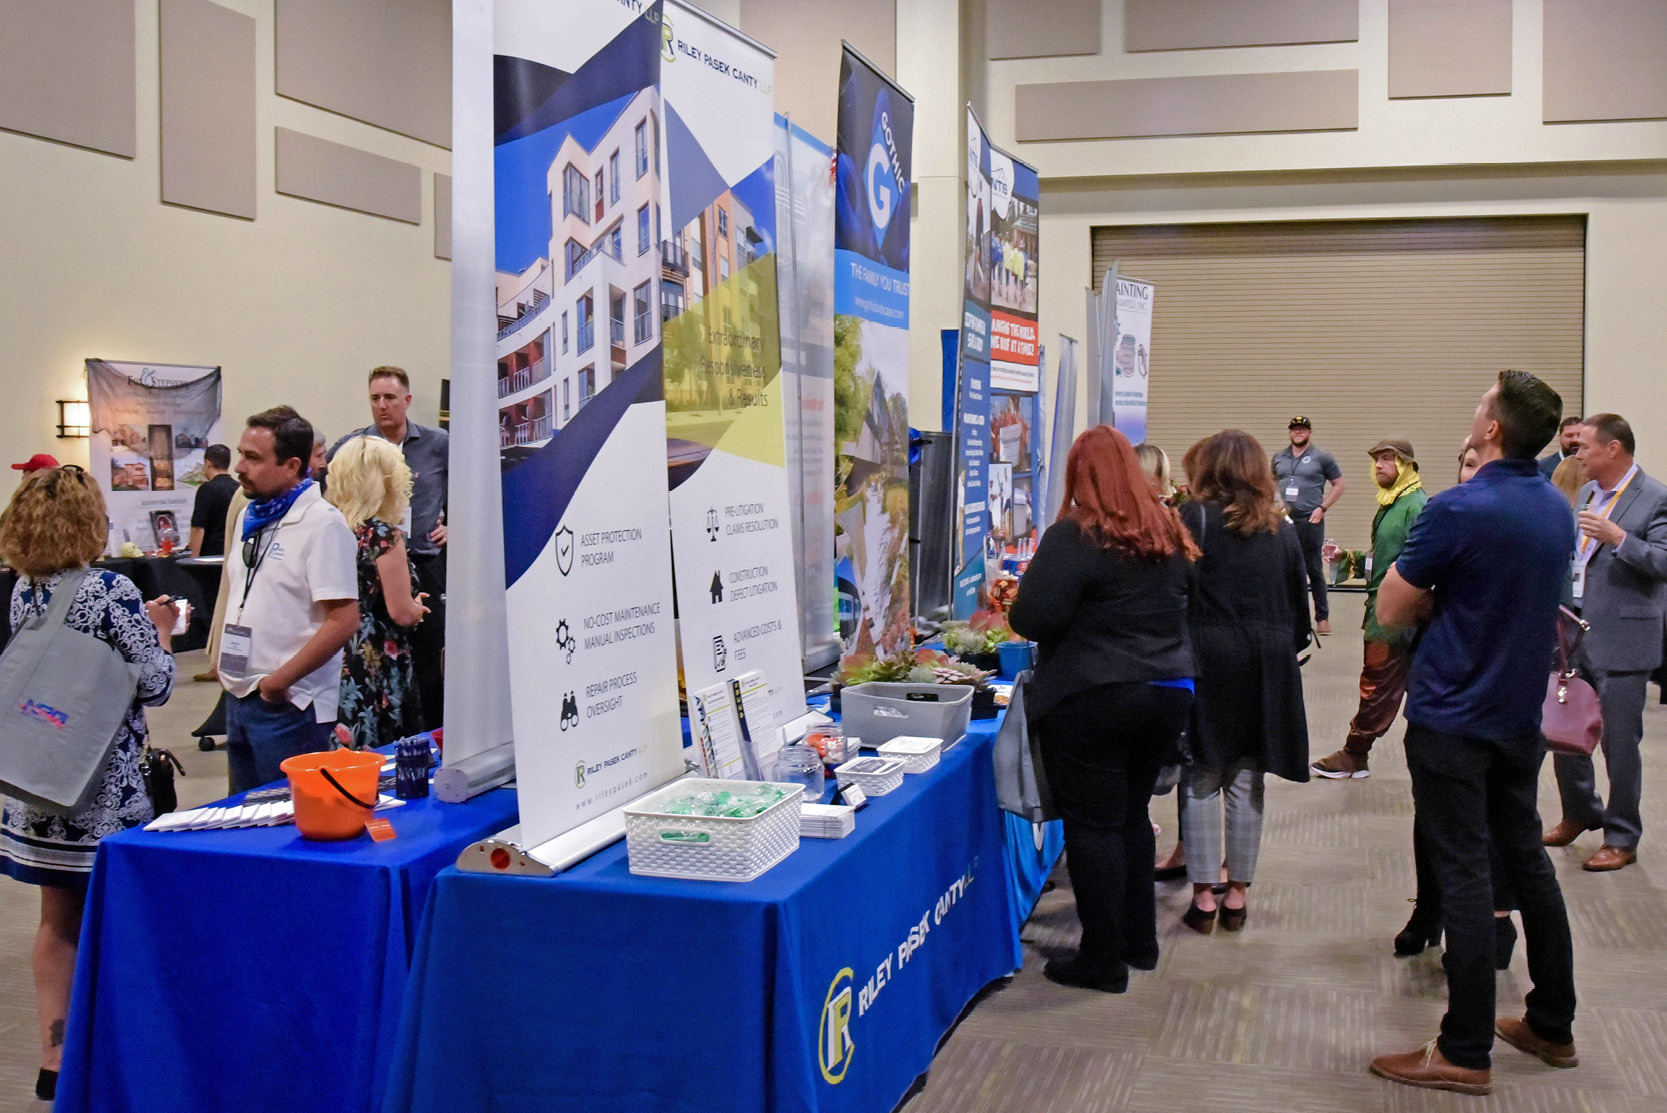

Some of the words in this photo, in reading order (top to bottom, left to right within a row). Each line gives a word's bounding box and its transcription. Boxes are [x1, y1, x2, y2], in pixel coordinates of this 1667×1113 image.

[677, 39, 702, 62] RILEY
[704, 51, 730, 76] PASEK
[733, 68, 758, 89] CANTY
[881, 111, 905, 194] GOTHIC
[867, 142, 891, 230] G
[850, 262, 863, 280] THE
[879, 273, 891, 291] YOU
[708, 325, 766, 353] Extraordinary
[701, 355, 767, 379] Responsiveness
[729, 388, 735, 406] &
[736, 388, 769, 407] Results
[724, 503, 764, 518] PRE-LITIGATION
[581, 532, 600, 547] ASSET
[601, 528, 642, 545] PROTECTION
[726, 522, 745, 536] CLAIMS
[745, 518, 779, 533] RESOLUTION
[581, 551, 614, 567] PROGRAM
[729, 566, 769, 584] CONSTRUCTION
[730, 586, 750, 602] DEFECT
[750, 581, 778, 597] LITIGATION
[584, 612, 613, 630] NO-COST
[614, 602, 660, 622] MAINTENANCE
[584, 631, 614, 650] MANUAL
[614, 622, 656, 643] INSPECTIONS
[733, 625, 760, 644] ADVANCED
[760, 621, 777, 636] COSTS
[734, 648, 747, 661] FEES
[586, 680, 609, 698] REPAIR
[609, 671, 638, 692] PROCESS
[586, 695, 624, 719] OVERSIGHT
[587, 763, 602, 775] RILEY
[603, 756, 620, 768] PASEK
[621, 748, 637, 761] CANTY
[575, 771, 648, 810] www.rileypasek.com
[858, 952, 893, 1017] RILEY
[898, 910, 931, 970] PASEK
[935, 874, 965, 926] CANTY
